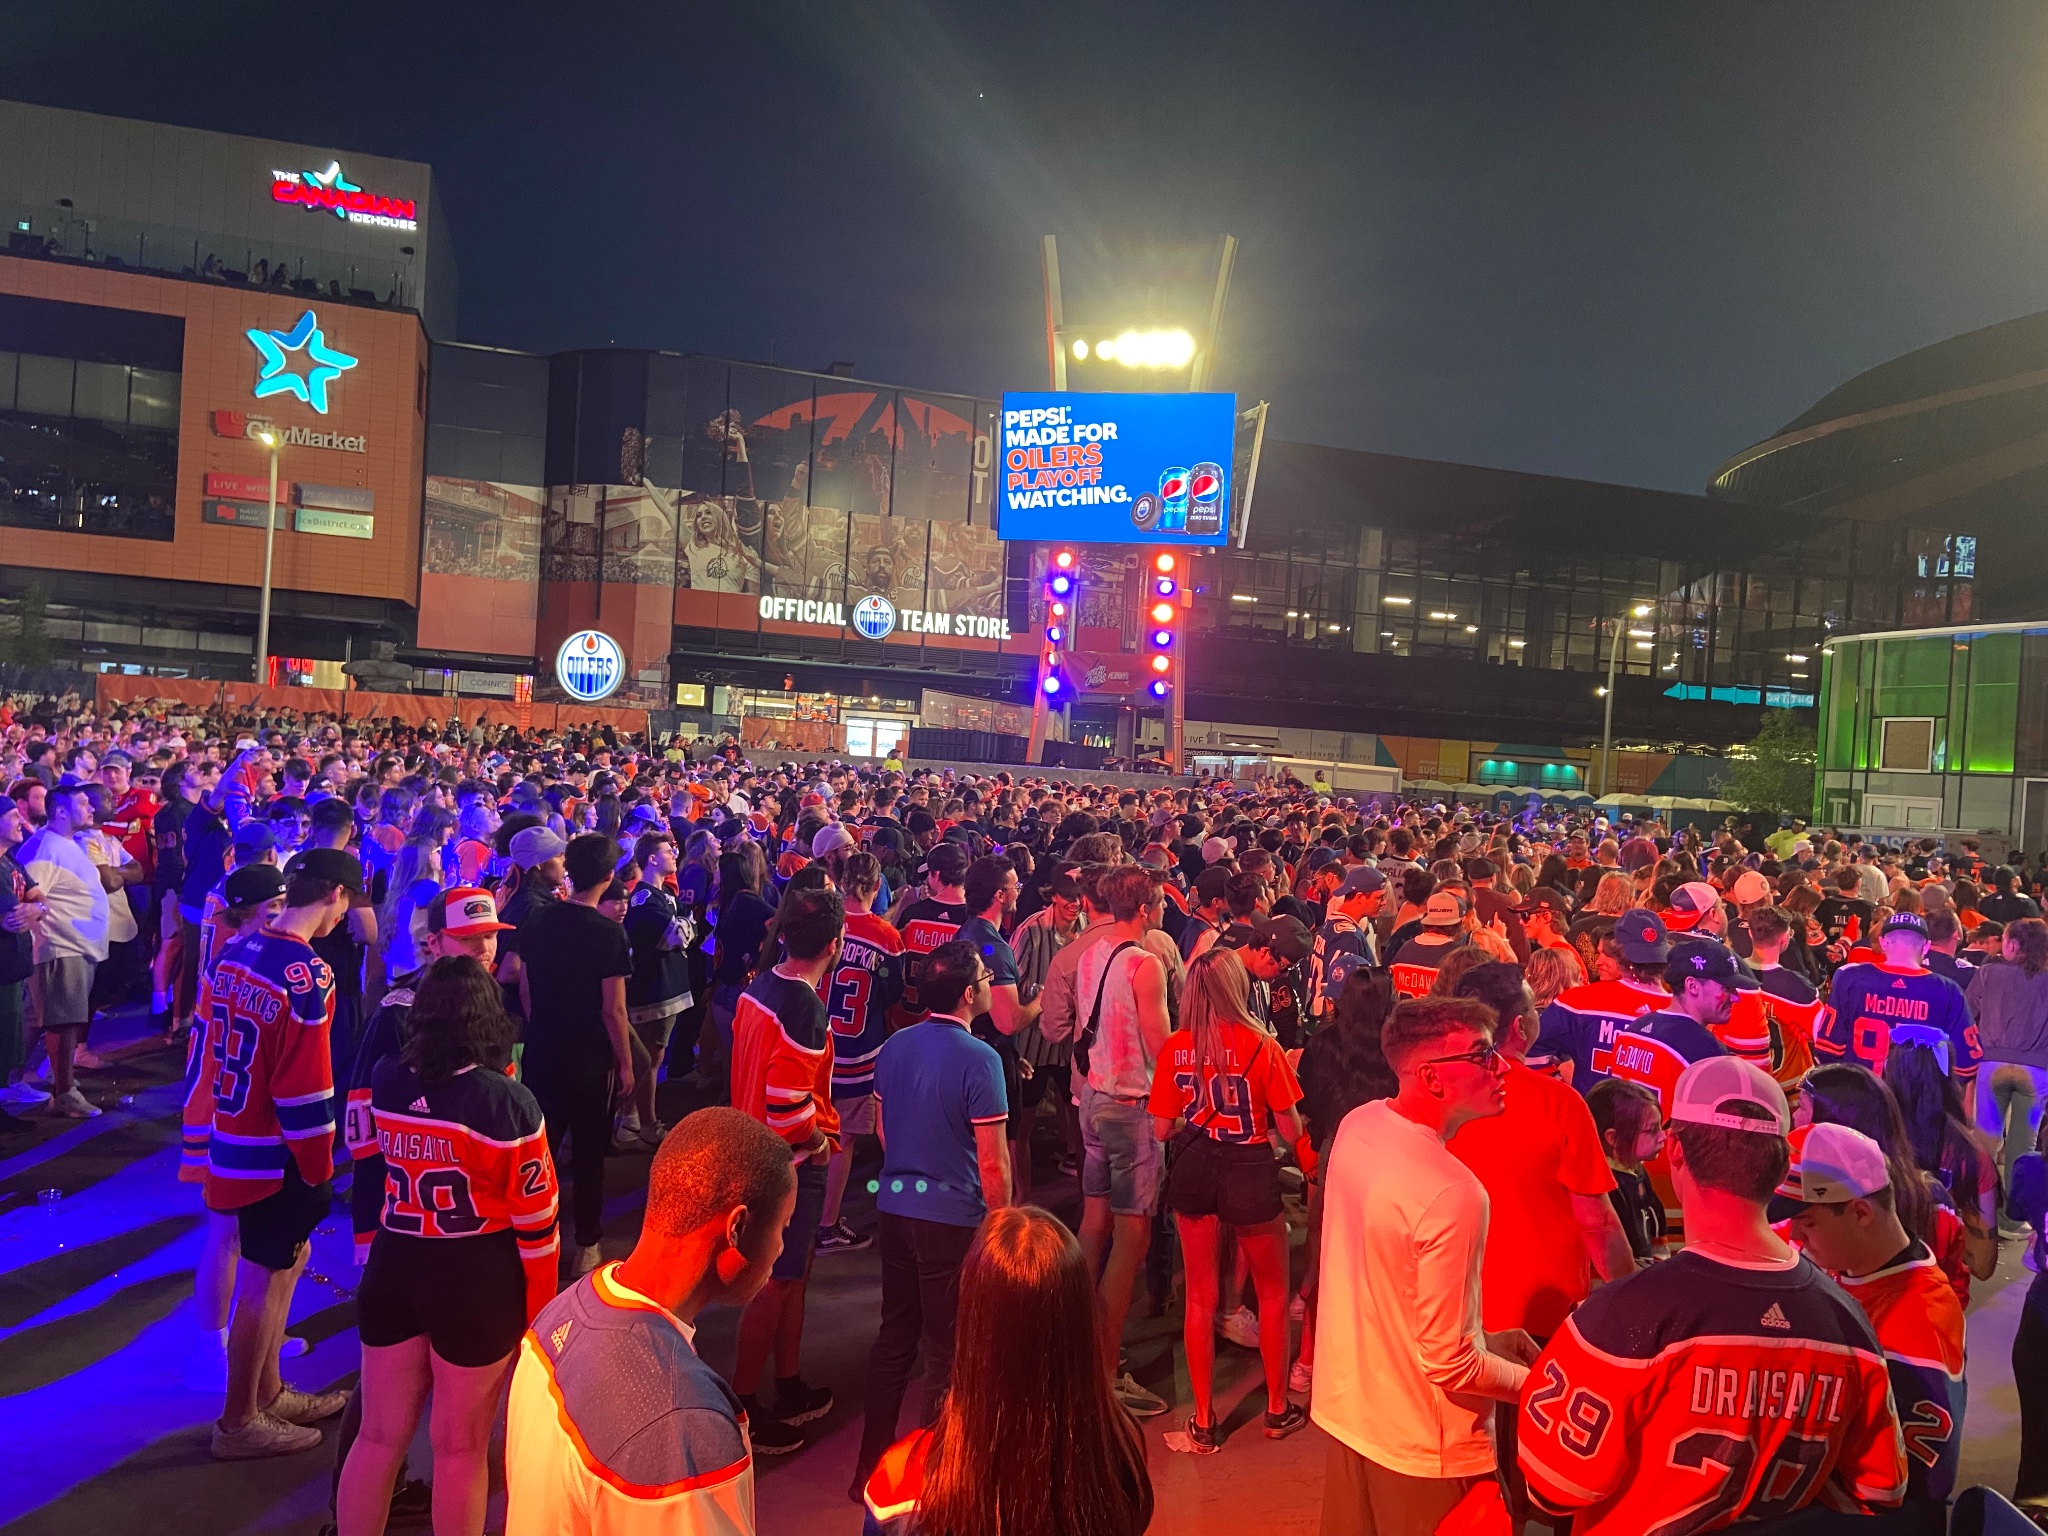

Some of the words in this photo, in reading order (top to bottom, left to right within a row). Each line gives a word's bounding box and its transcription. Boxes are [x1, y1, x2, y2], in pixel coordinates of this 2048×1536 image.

[272, 170, 300, 183] THE
[272, 181, 415, 219] CANADIAN
[349, 212, 417, 231] ICEHOUSE
[1006, 425, 1070, 448] MADE
[1073, 422, 1118, 442] FOR
[1007, 442, 1103, 471] OILERS
[1008, 467, 1102, 491] PLAYOFF
[1007, 484, 1132, 510] WATCHING.
[1193, 505, 1216, 515] pepsi
[759, 595, 847, 626] OFFICIAL
[900, 609, 950, 635] TEAM
[955, 614, 1012, 640] STORE
[470, 678, 513, 690] CONNECT
[567, 655, 613, 695] OILERS
[283, 956, 333, 995] 93
[1864, 992, 1930, 1021] McDAVID
[1760, 1317, 1791, 1329] adidas
[1690, 1365, 1844, 1423] DRAISAITL
[1525, 1358, 1614, 1460] 29
